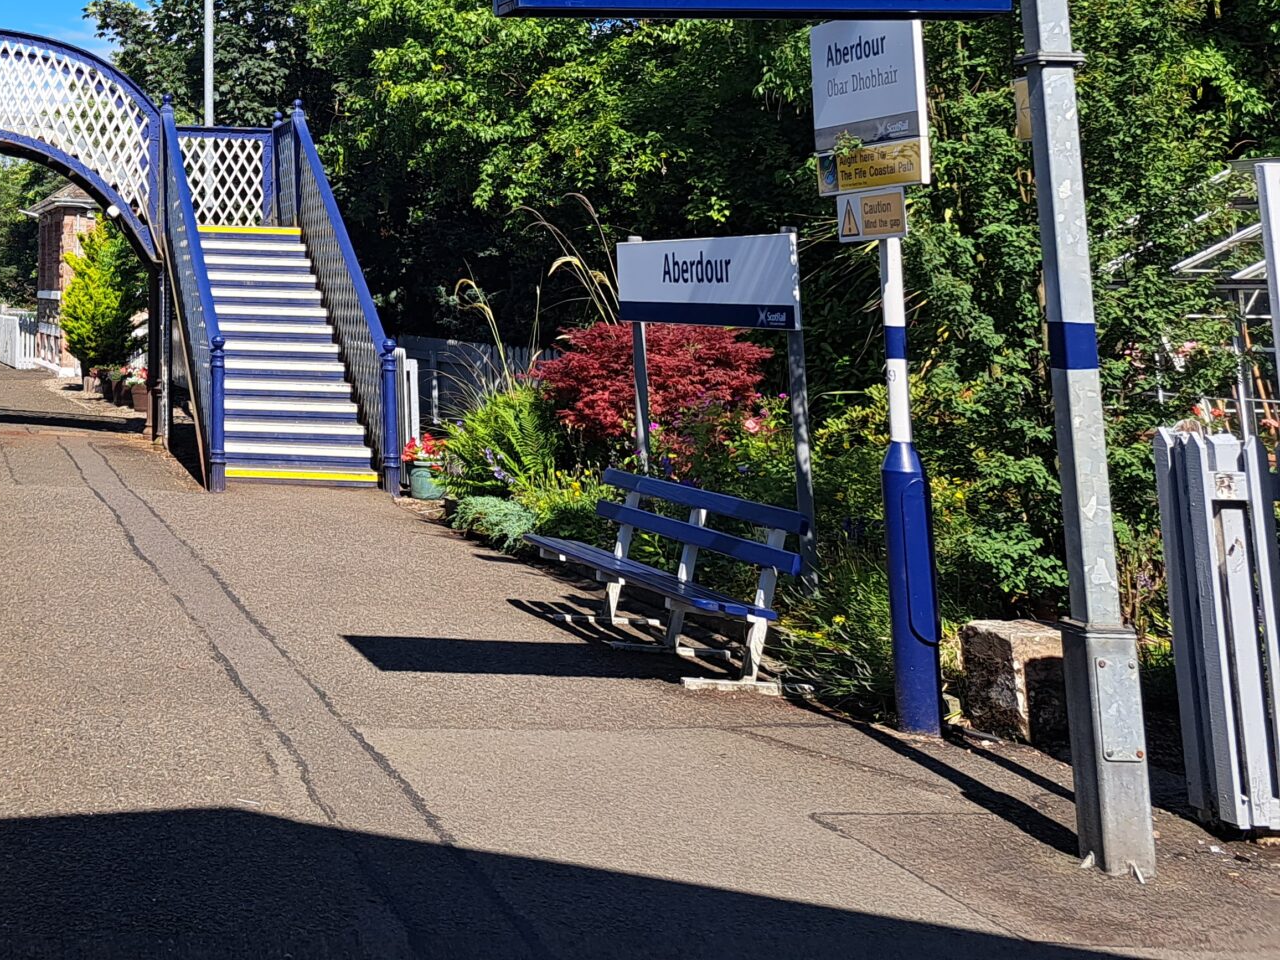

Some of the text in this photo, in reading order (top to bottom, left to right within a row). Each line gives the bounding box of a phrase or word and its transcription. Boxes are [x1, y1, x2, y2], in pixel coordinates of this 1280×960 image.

[826, 35, 886, 68] Aberdour
[827, 64, 898, 97] Obar Dhobhair
[860, 152, 875, 163] here
[840, 160, 914, 181] The Fife Coastal Path
[863, 201, 892, 215] Caution
[864, 219, 900, 229] Mind the gap
[662, 250, 732, 283] Aberdour
